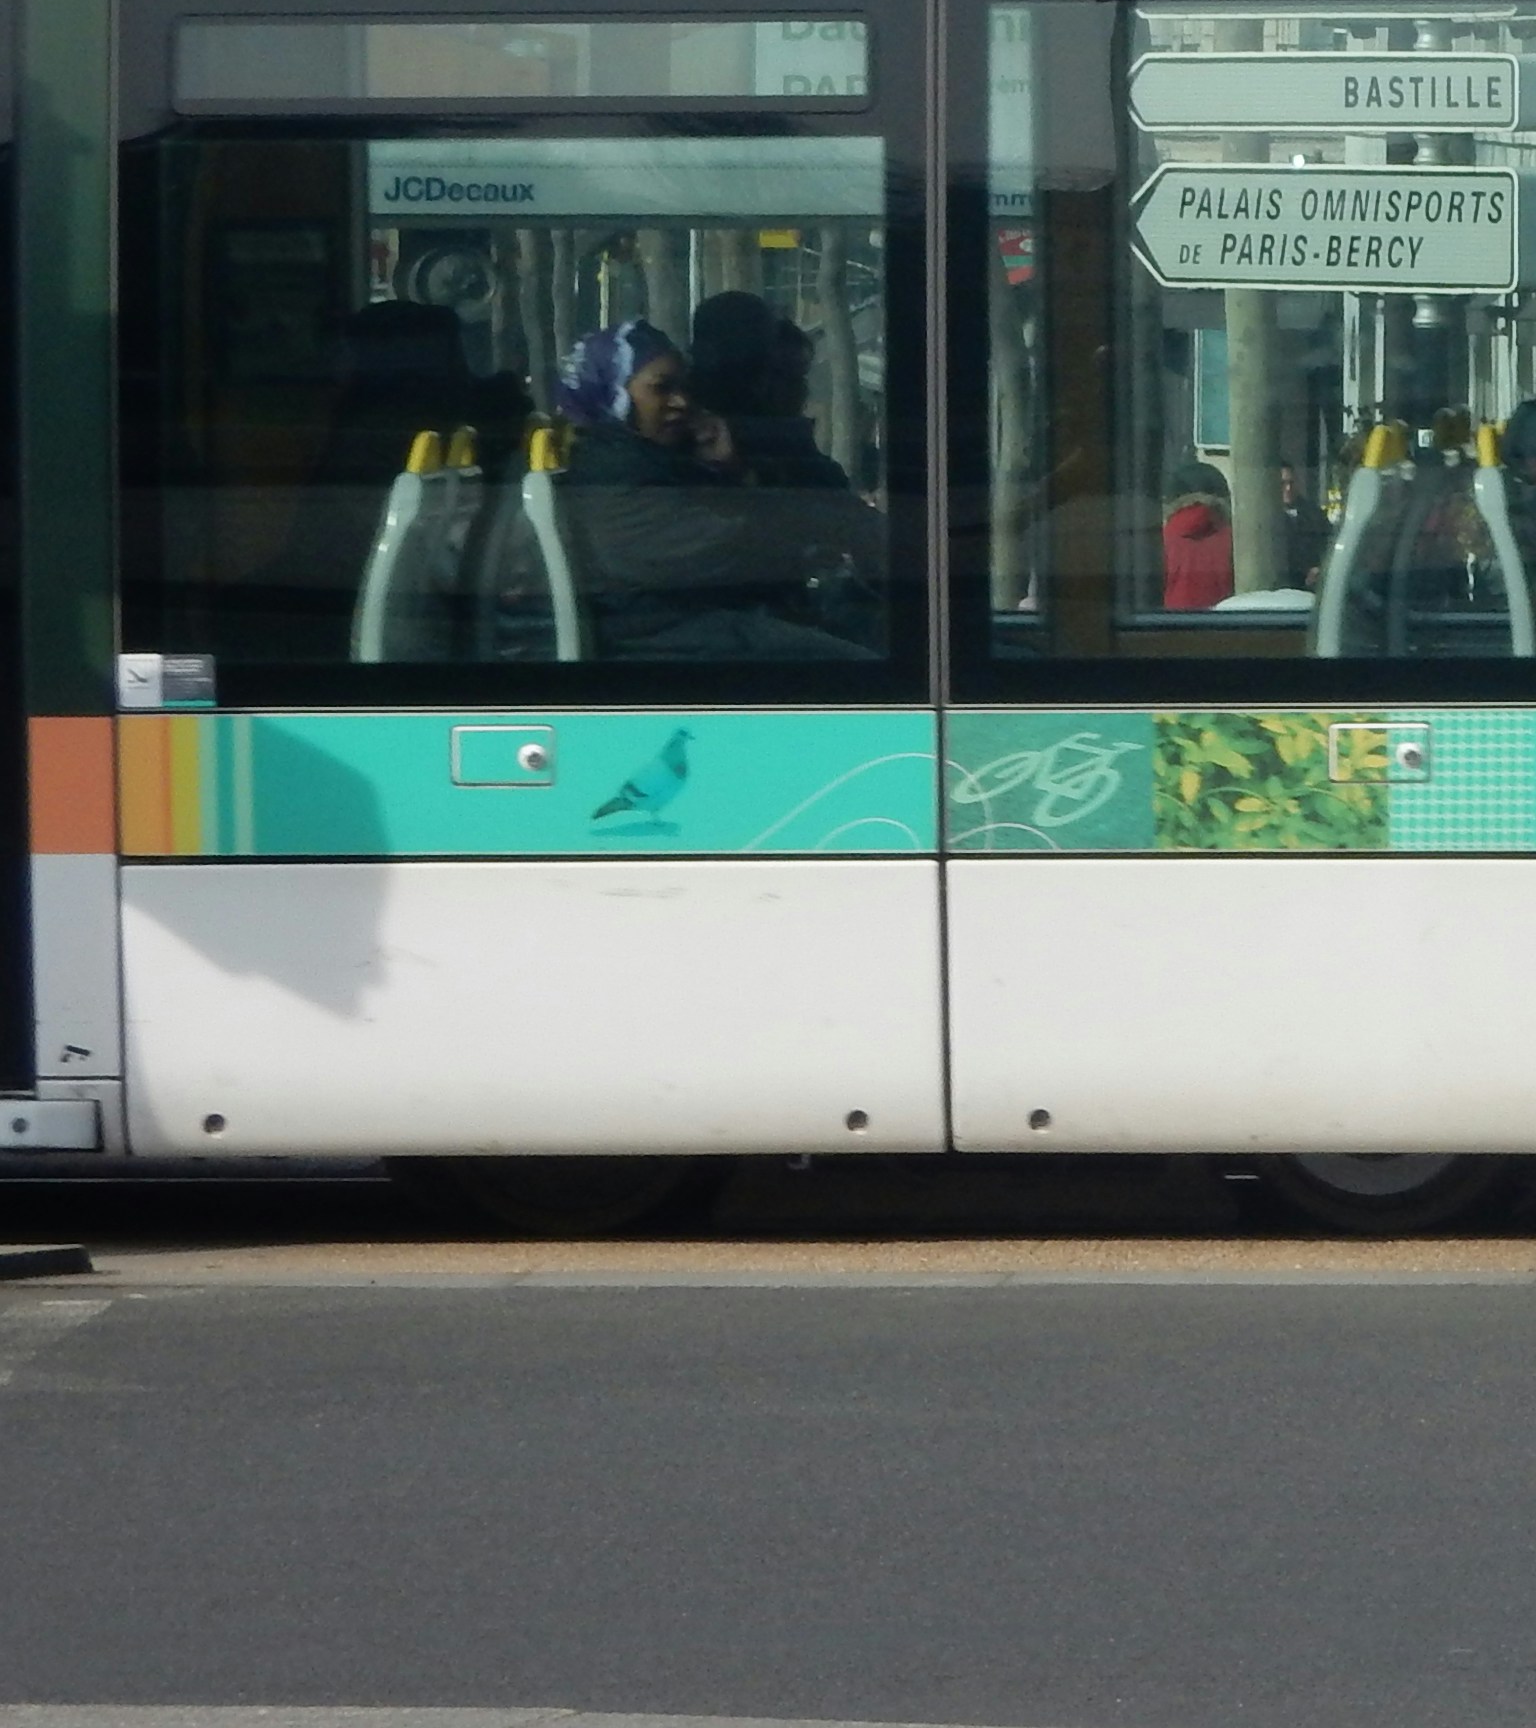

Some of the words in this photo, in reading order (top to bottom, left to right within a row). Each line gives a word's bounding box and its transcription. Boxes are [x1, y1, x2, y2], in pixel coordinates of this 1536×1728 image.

[1344, 76, 1503, 109] BASTILLE
[383, 176, 535, 202] JCDecaux
[1178, 187, 1283, 221] PALAIS
[1300, 188, 1505, 224] OMNISPORTS
[1179, 244, 1202, 265] DE
[1219, 233, 1425, 270] PARIS-BERCY
